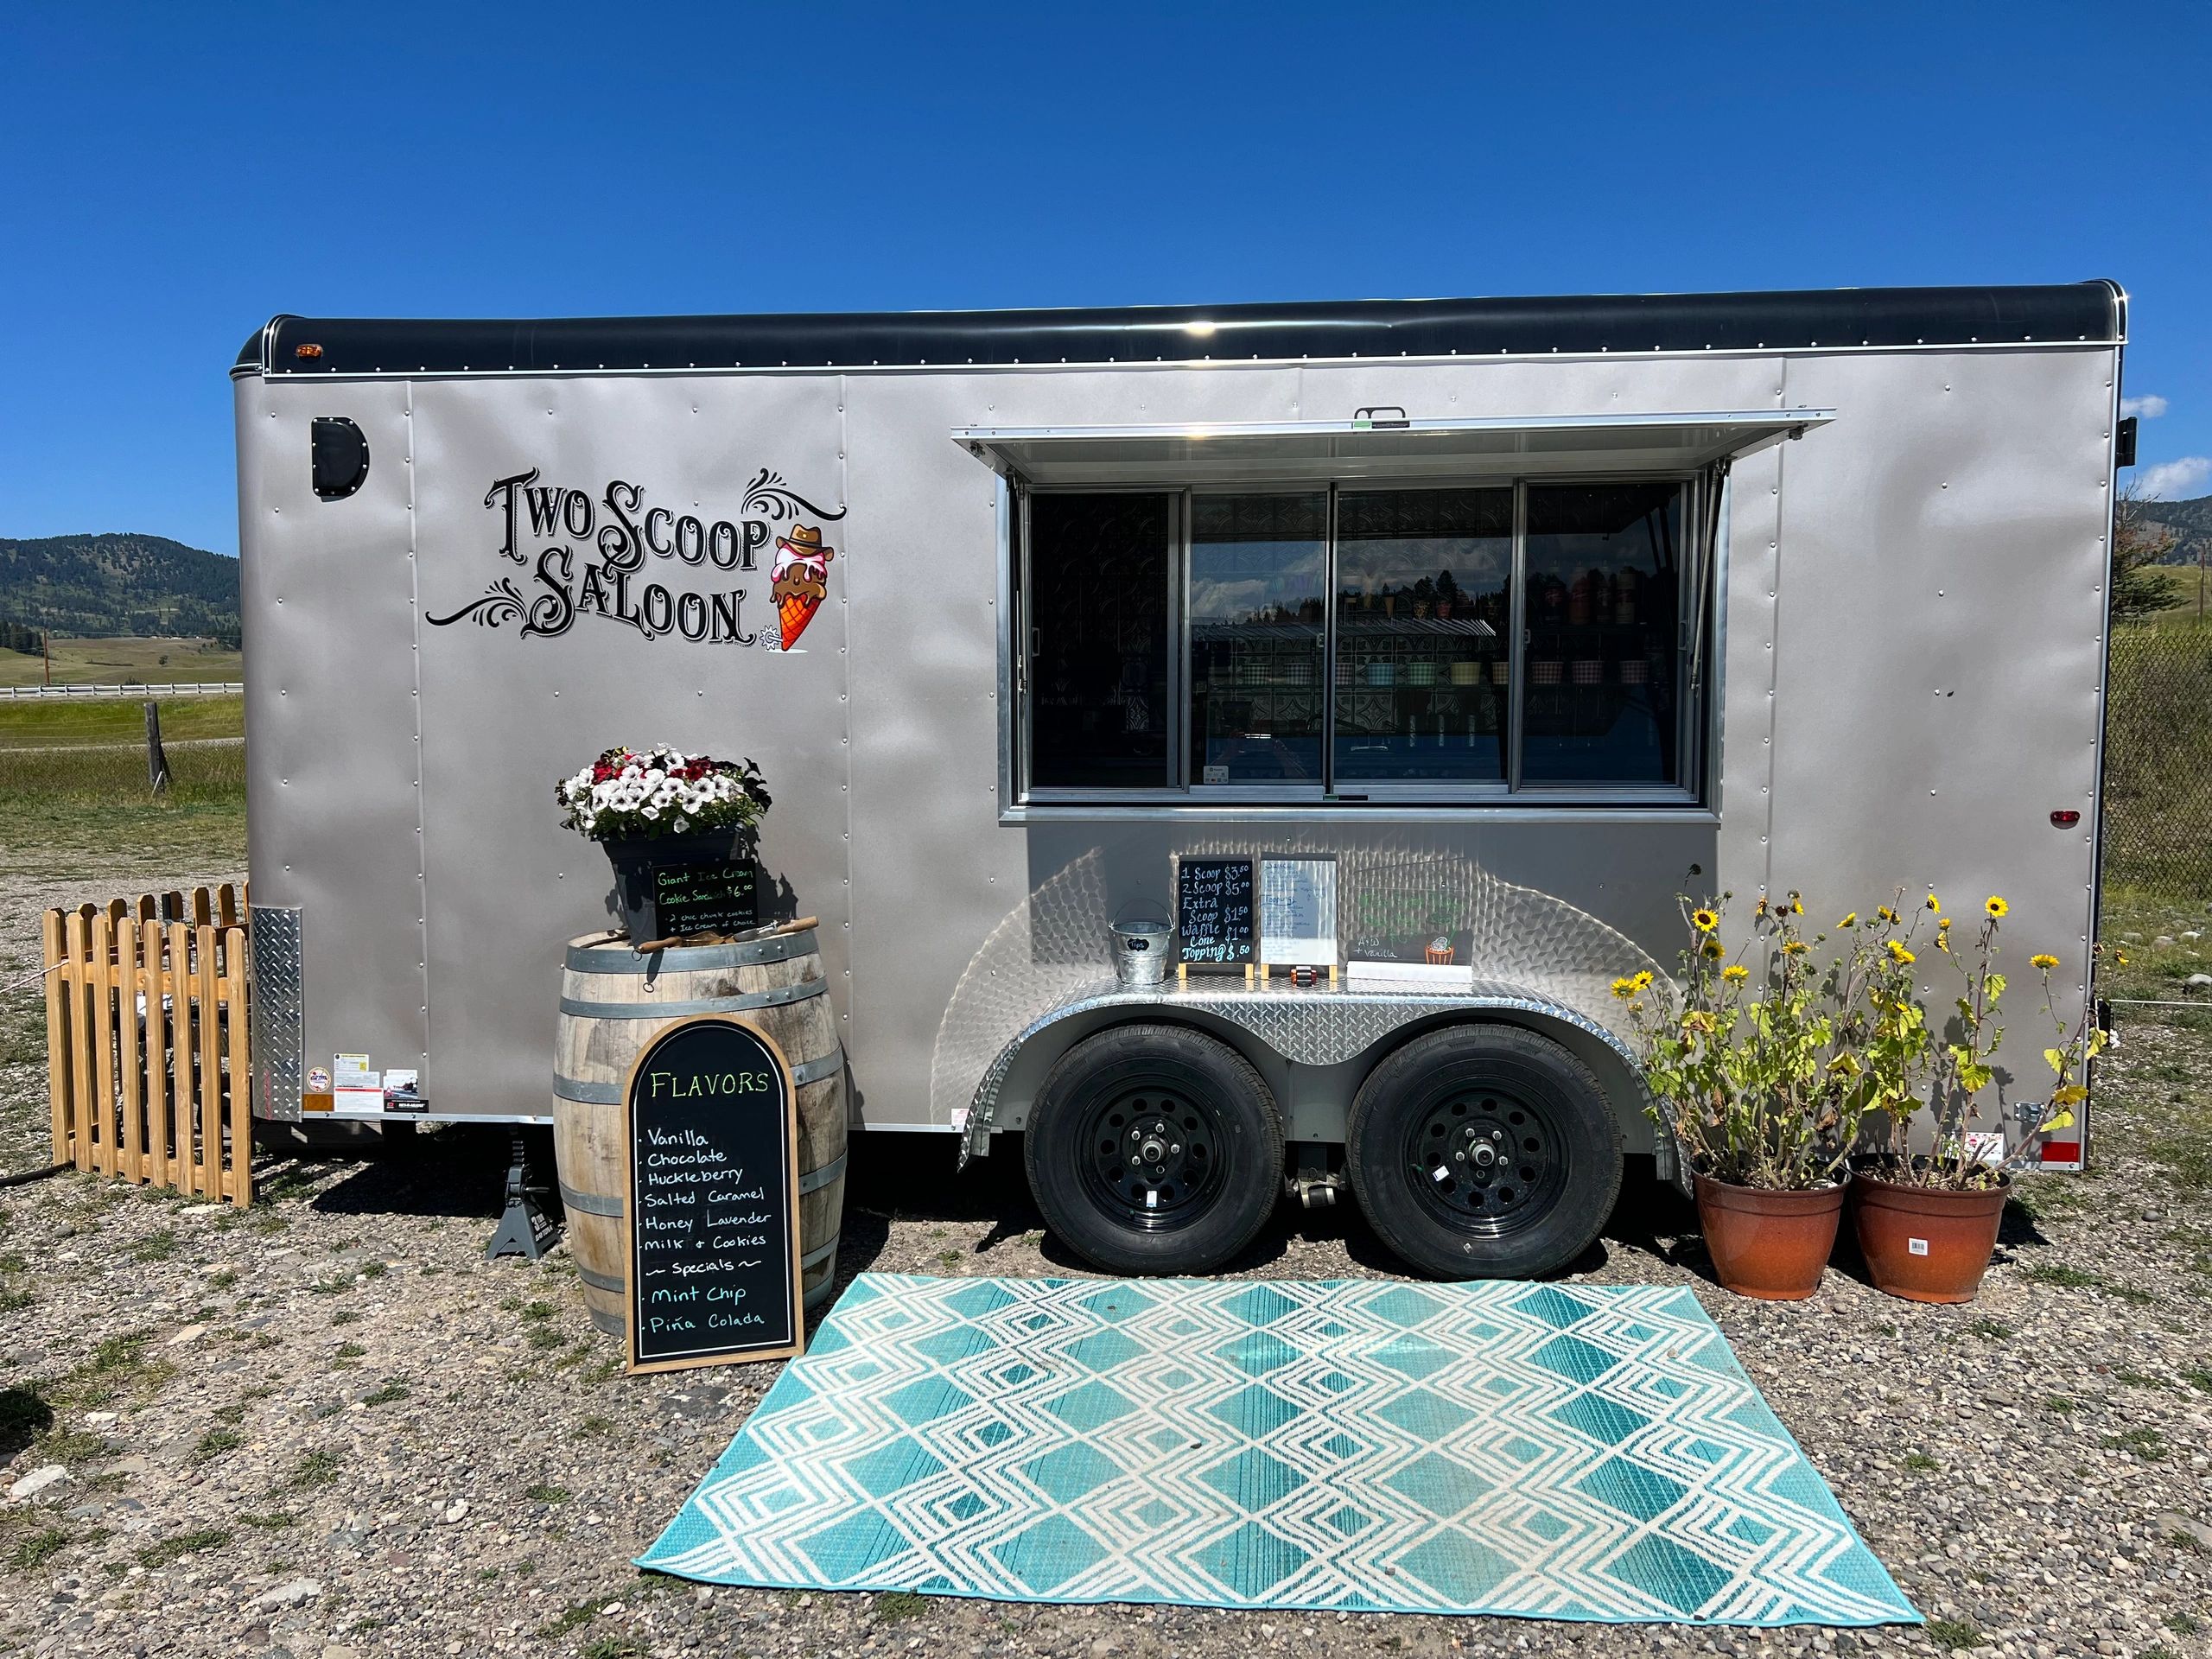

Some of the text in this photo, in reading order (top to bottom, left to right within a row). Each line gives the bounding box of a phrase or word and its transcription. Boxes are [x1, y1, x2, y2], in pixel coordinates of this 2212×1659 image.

[658, 868, 753, 887] Giant Ice Cream
[1181, 865, 1249, 881] 1 Scoop $3.50
[1182, 883, 1193, 893] 2
[1192, 882, 1224, 895] Scoop
[1225, 881, 1250, 896] $5.00
[659, 893, 690, 906] Cookie
[1183, 897, 1218, 910] Extra
[1189, 906, 1249, 925] Scoop $1.50
[679, 925, 693, 933] Ice
[1225, 925, 1249, 944] $1.00
[1128, 940, 1145, 949] Tips
[1190, 935, 1216, 947] Cone
[1182, 944, 1227, 962] Topping
[1363, 949, 1398, 958] Vanilla
[650, 1071, 769, 1098] FLAVORS
[647, 1128, 709, 1147] Vanilla
[647, 1148, 728, 1167] Chocolate
[648, 1168, 743, 1186] Huckleberry
[644, 1186, 765, 1208] Salted Caramel
[645, 1210, 772, 1233] Honey Lavender
[645, 1238, 684, 1251] Milk
[713, 1235, 766, 1249] Cookies
[672, 1258, 734, 1277] Specials
[652, 1285, 747, 1306] Mint Chip
[650, 1313, 765, 1333] Piña Colada
